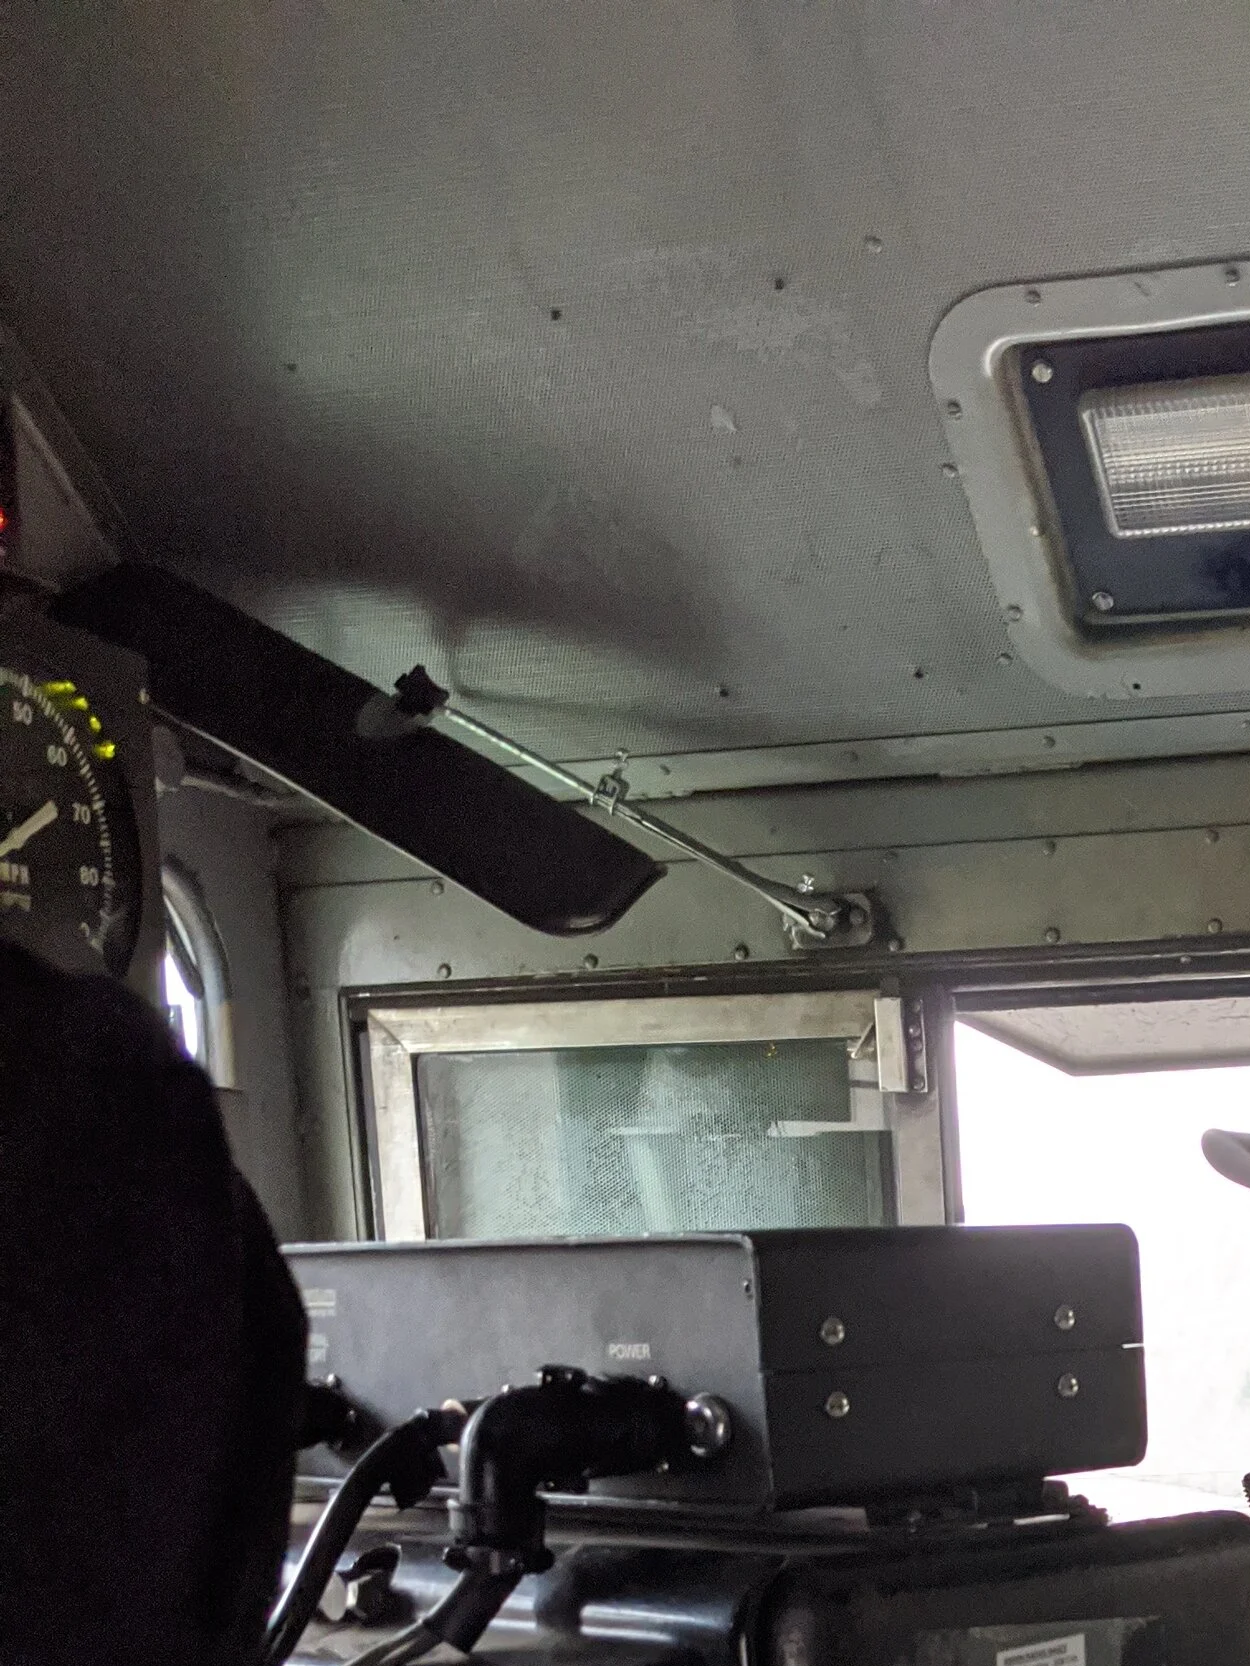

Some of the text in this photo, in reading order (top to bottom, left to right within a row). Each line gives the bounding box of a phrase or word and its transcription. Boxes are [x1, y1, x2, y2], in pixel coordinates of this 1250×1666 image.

[46, 744, 68, 767] 60
[72, 802, 91, 825] 70
[80, 865, 99, 887] 80
[608, 1343, 651, 1361] POWER
